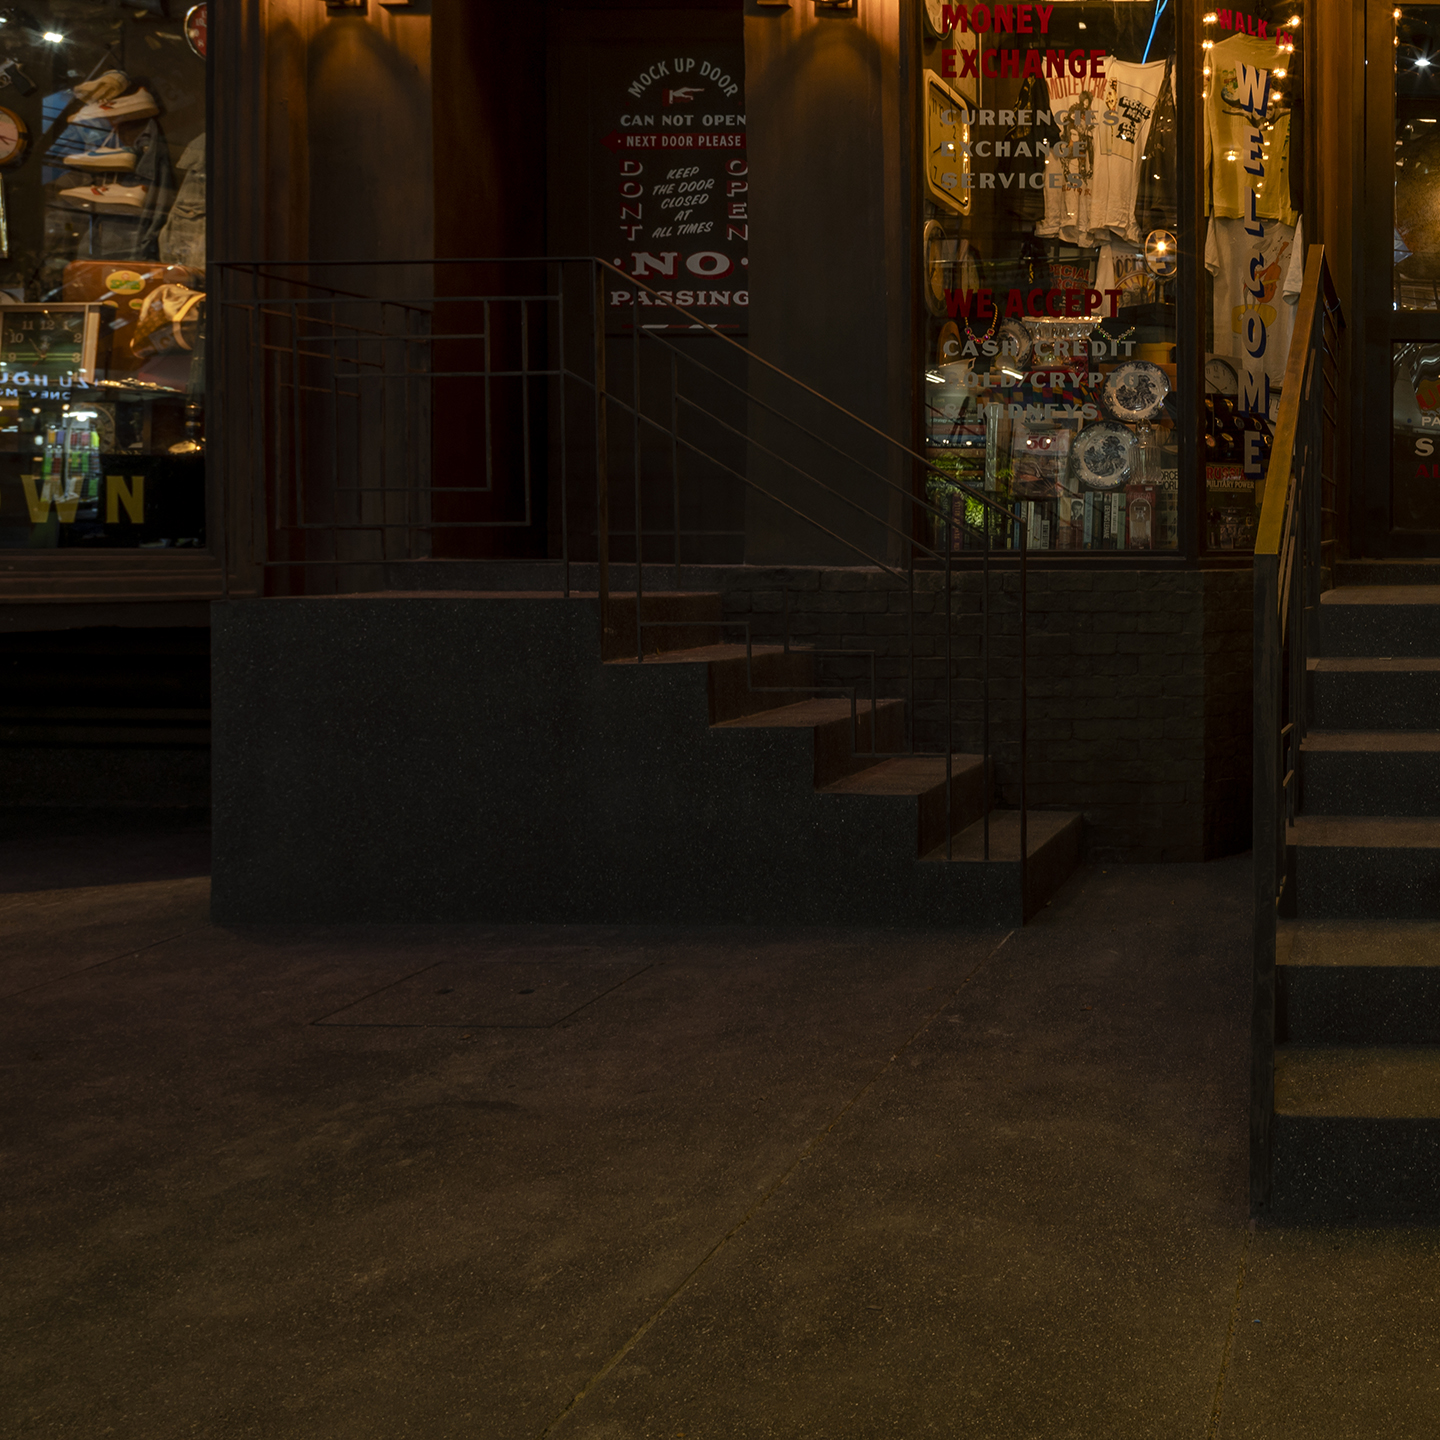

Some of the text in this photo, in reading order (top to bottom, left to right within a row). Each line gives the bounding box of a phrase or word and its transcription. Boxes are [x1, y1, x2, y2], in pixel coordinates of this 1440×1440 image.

[940, 4, 1054, 34] MONEY
[1216, 7, 1269, 41] WALK
[940, 49, 1107, 79] EXCHANGE
[627, 58, 739, 99] MOCK UP DOOR
[620, 114, 747, 127] CAN NOT OPEN
[940, 109, 1120, 127] CURRENCIES
[626, 135, 742, 147] NEXT DOOR PLEASE
[940, 140, 1087, 159] EXCHANGE
[666, 166, 700, 180] KEEP
[940, 172, 1083, 190] SERVICES
[652, 178, 715, 196] THE DOOR
[618, 158, 644, 242] DONT
[660, 193, 709, 210] CLOSED
[725, 158, 748, 242] OPEN
[674, 209, 693, 222] AT
[652, 221, 714, 239] ALL TIMES
[631, 250, 735, 280] NO
[1235, 60, 1272, 480] WELCOME
[610, 290, 749, 308] PASSING
[944, 288, 1123, 320] WE ACCEPT
[977, 403, 1099, 420] KIDNEYS
